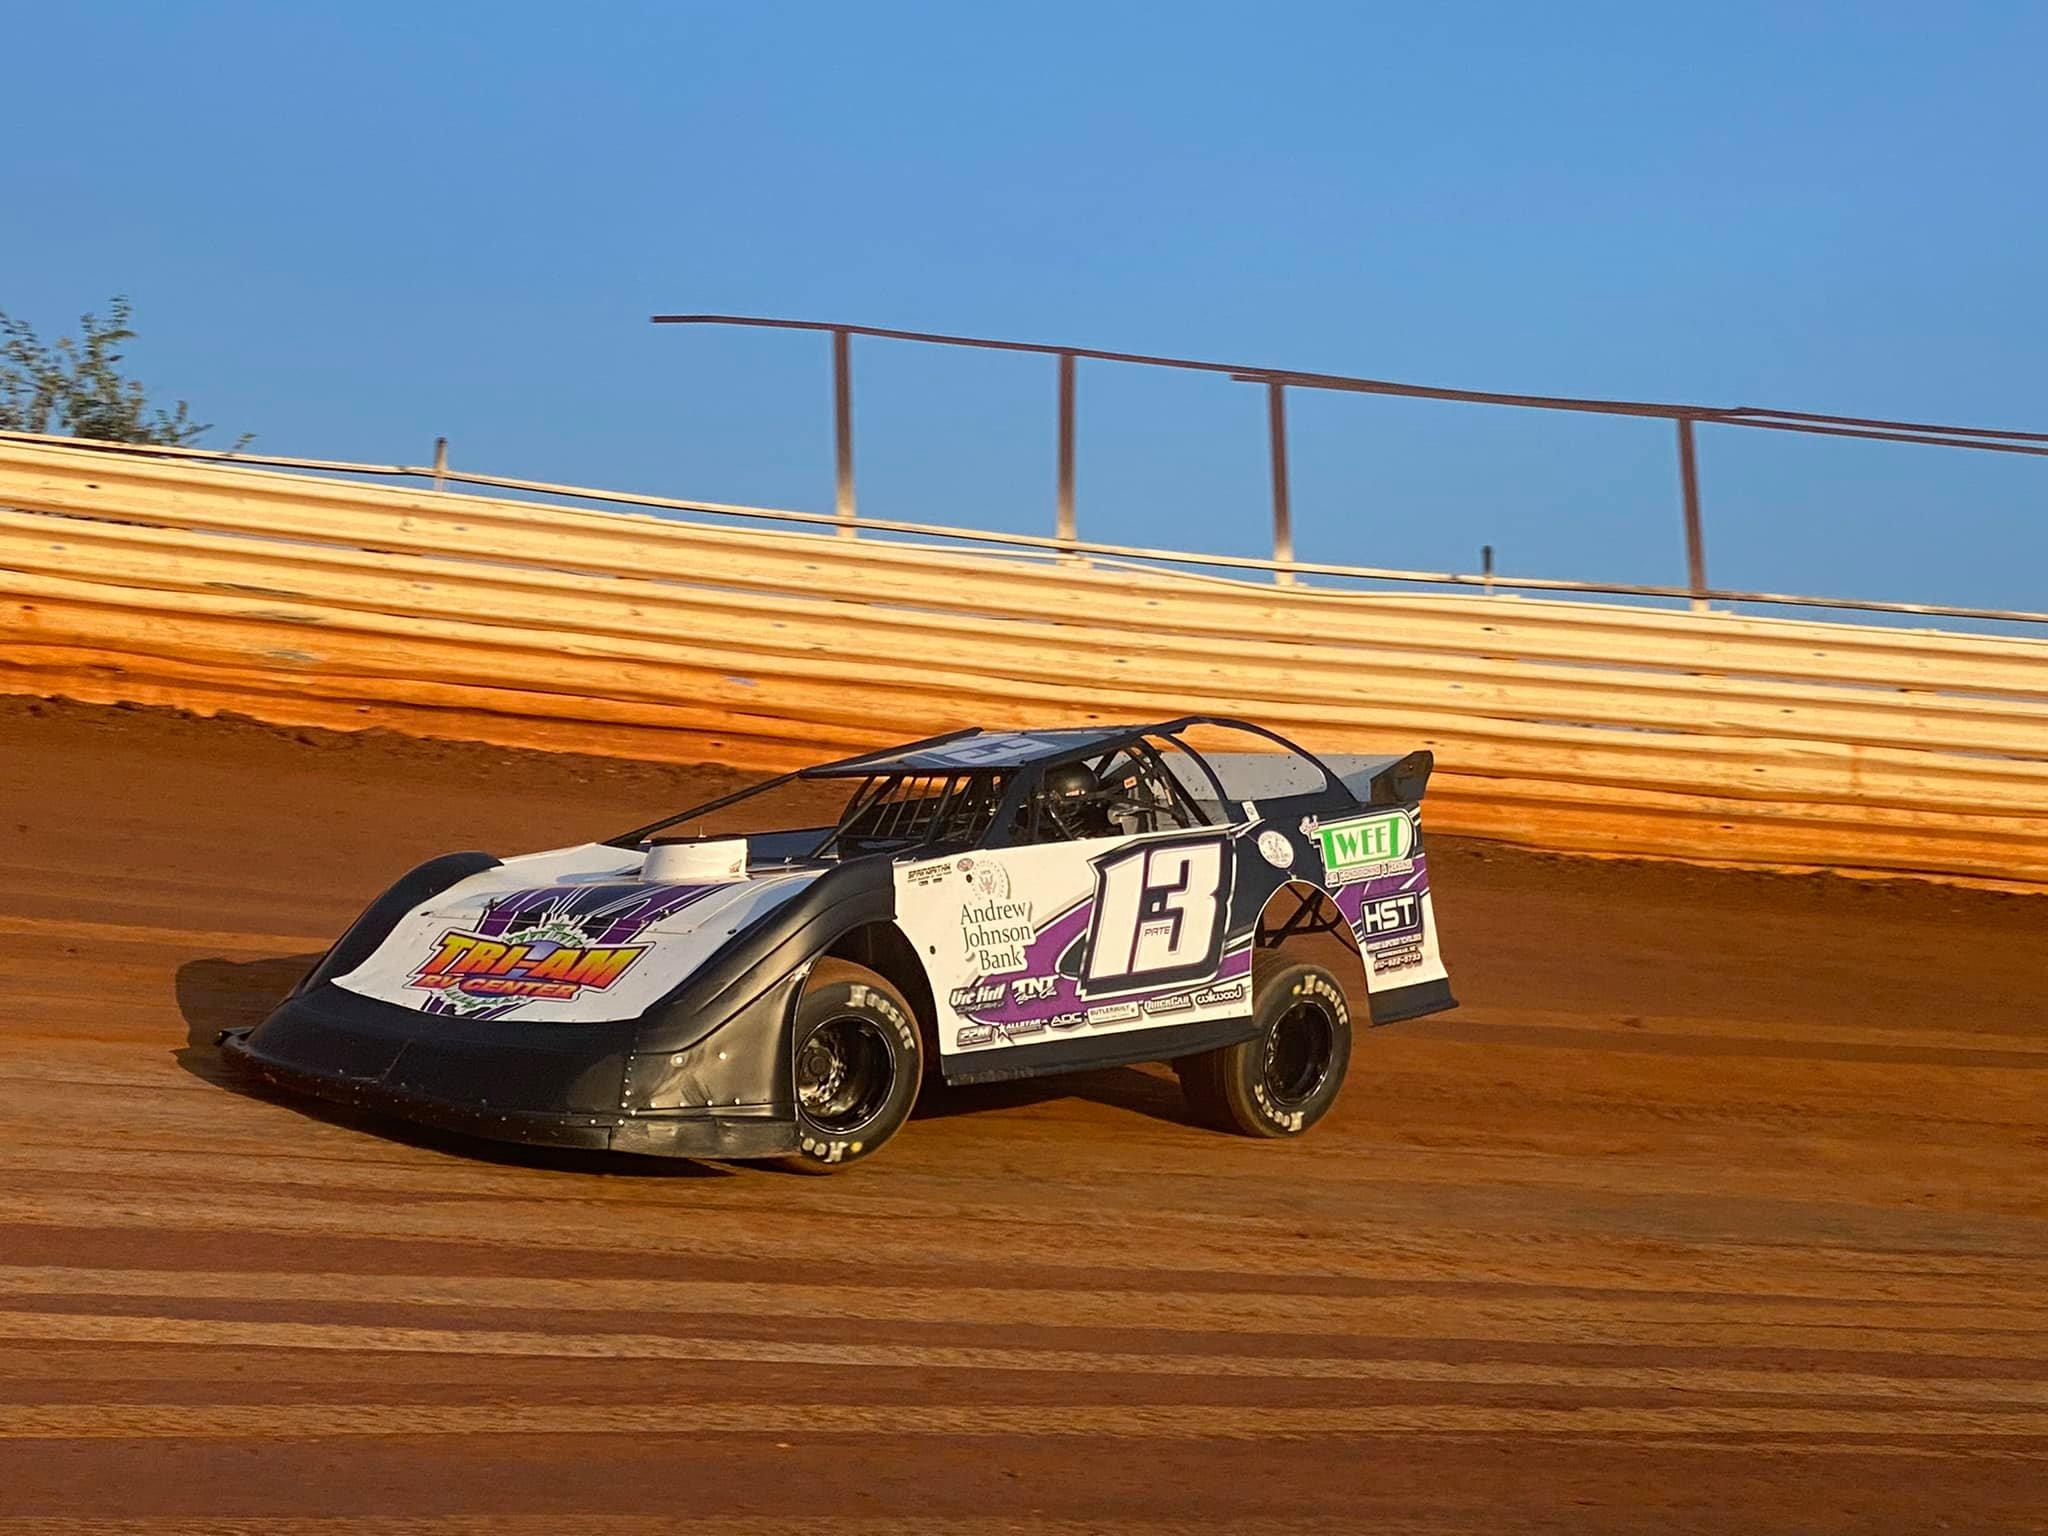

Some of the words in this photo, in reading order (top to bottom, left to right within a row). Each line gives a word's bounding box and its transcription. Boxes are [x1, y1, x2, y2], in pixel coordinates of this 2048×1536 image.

[961, 899, 1026, 924] Andrew
[1089, 843, 1221, 979] 13
[1363, 896, 1415, 933] HST
[963, 925, 1031, 953] Johnson
[417, 931, 649, 988] TRI-AM
[979, 945, 1023, 971] Bank
[411, 974, 457, 989] RV
[463, 978, 581, 999] CENTER
[1012, 975, 1059, 996] TNT
[1197, 984, 1242, 1004] wilwood
